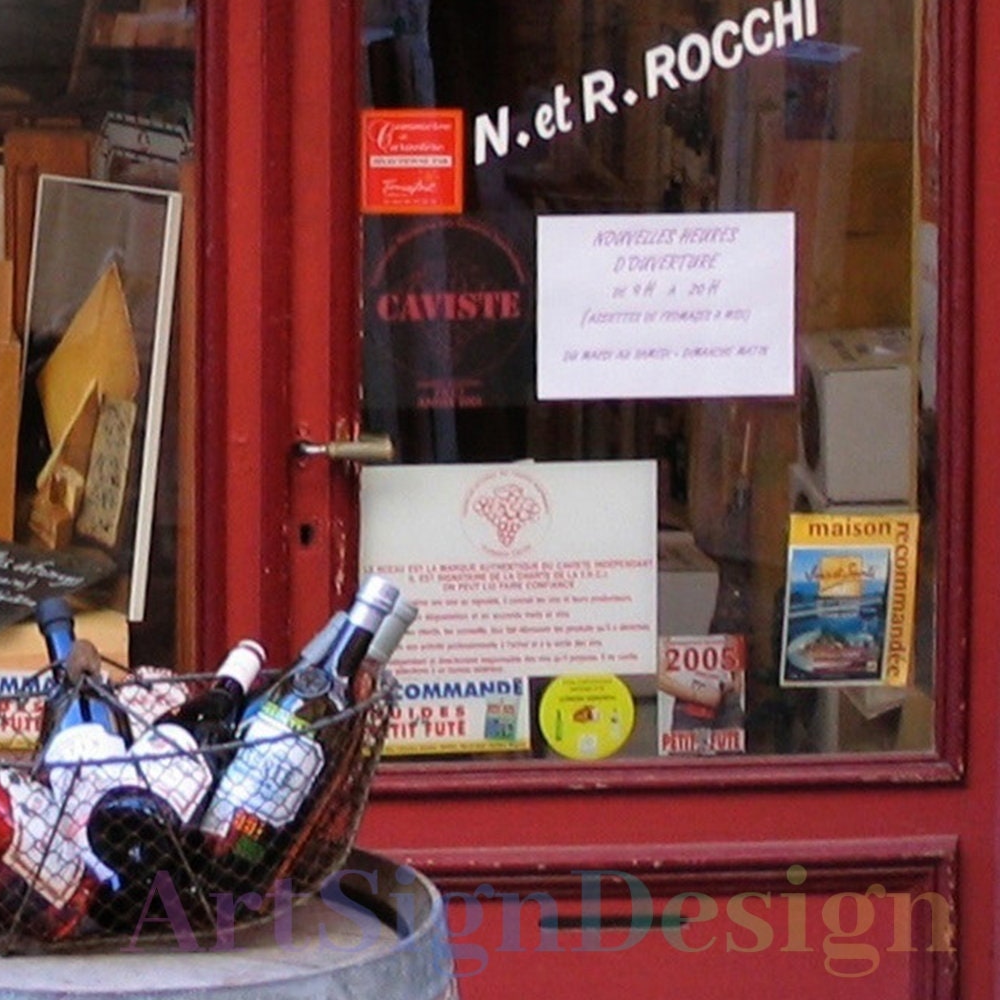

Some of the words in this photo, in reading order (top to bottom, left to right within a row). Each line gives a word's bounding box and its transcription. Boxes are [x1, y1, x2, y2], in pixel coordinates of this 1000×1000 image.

[535, 84, 572, 140] et
[593, 229, 677, 246] NOUVELLES
[679, 227, 740, 244] HEURES
[376, 290, 521, 322] CAVISTE
[808, 519, 892, 537] maison
[887, 521, 909, 678] recommandée
[665, 646, 738, 672] 2005
